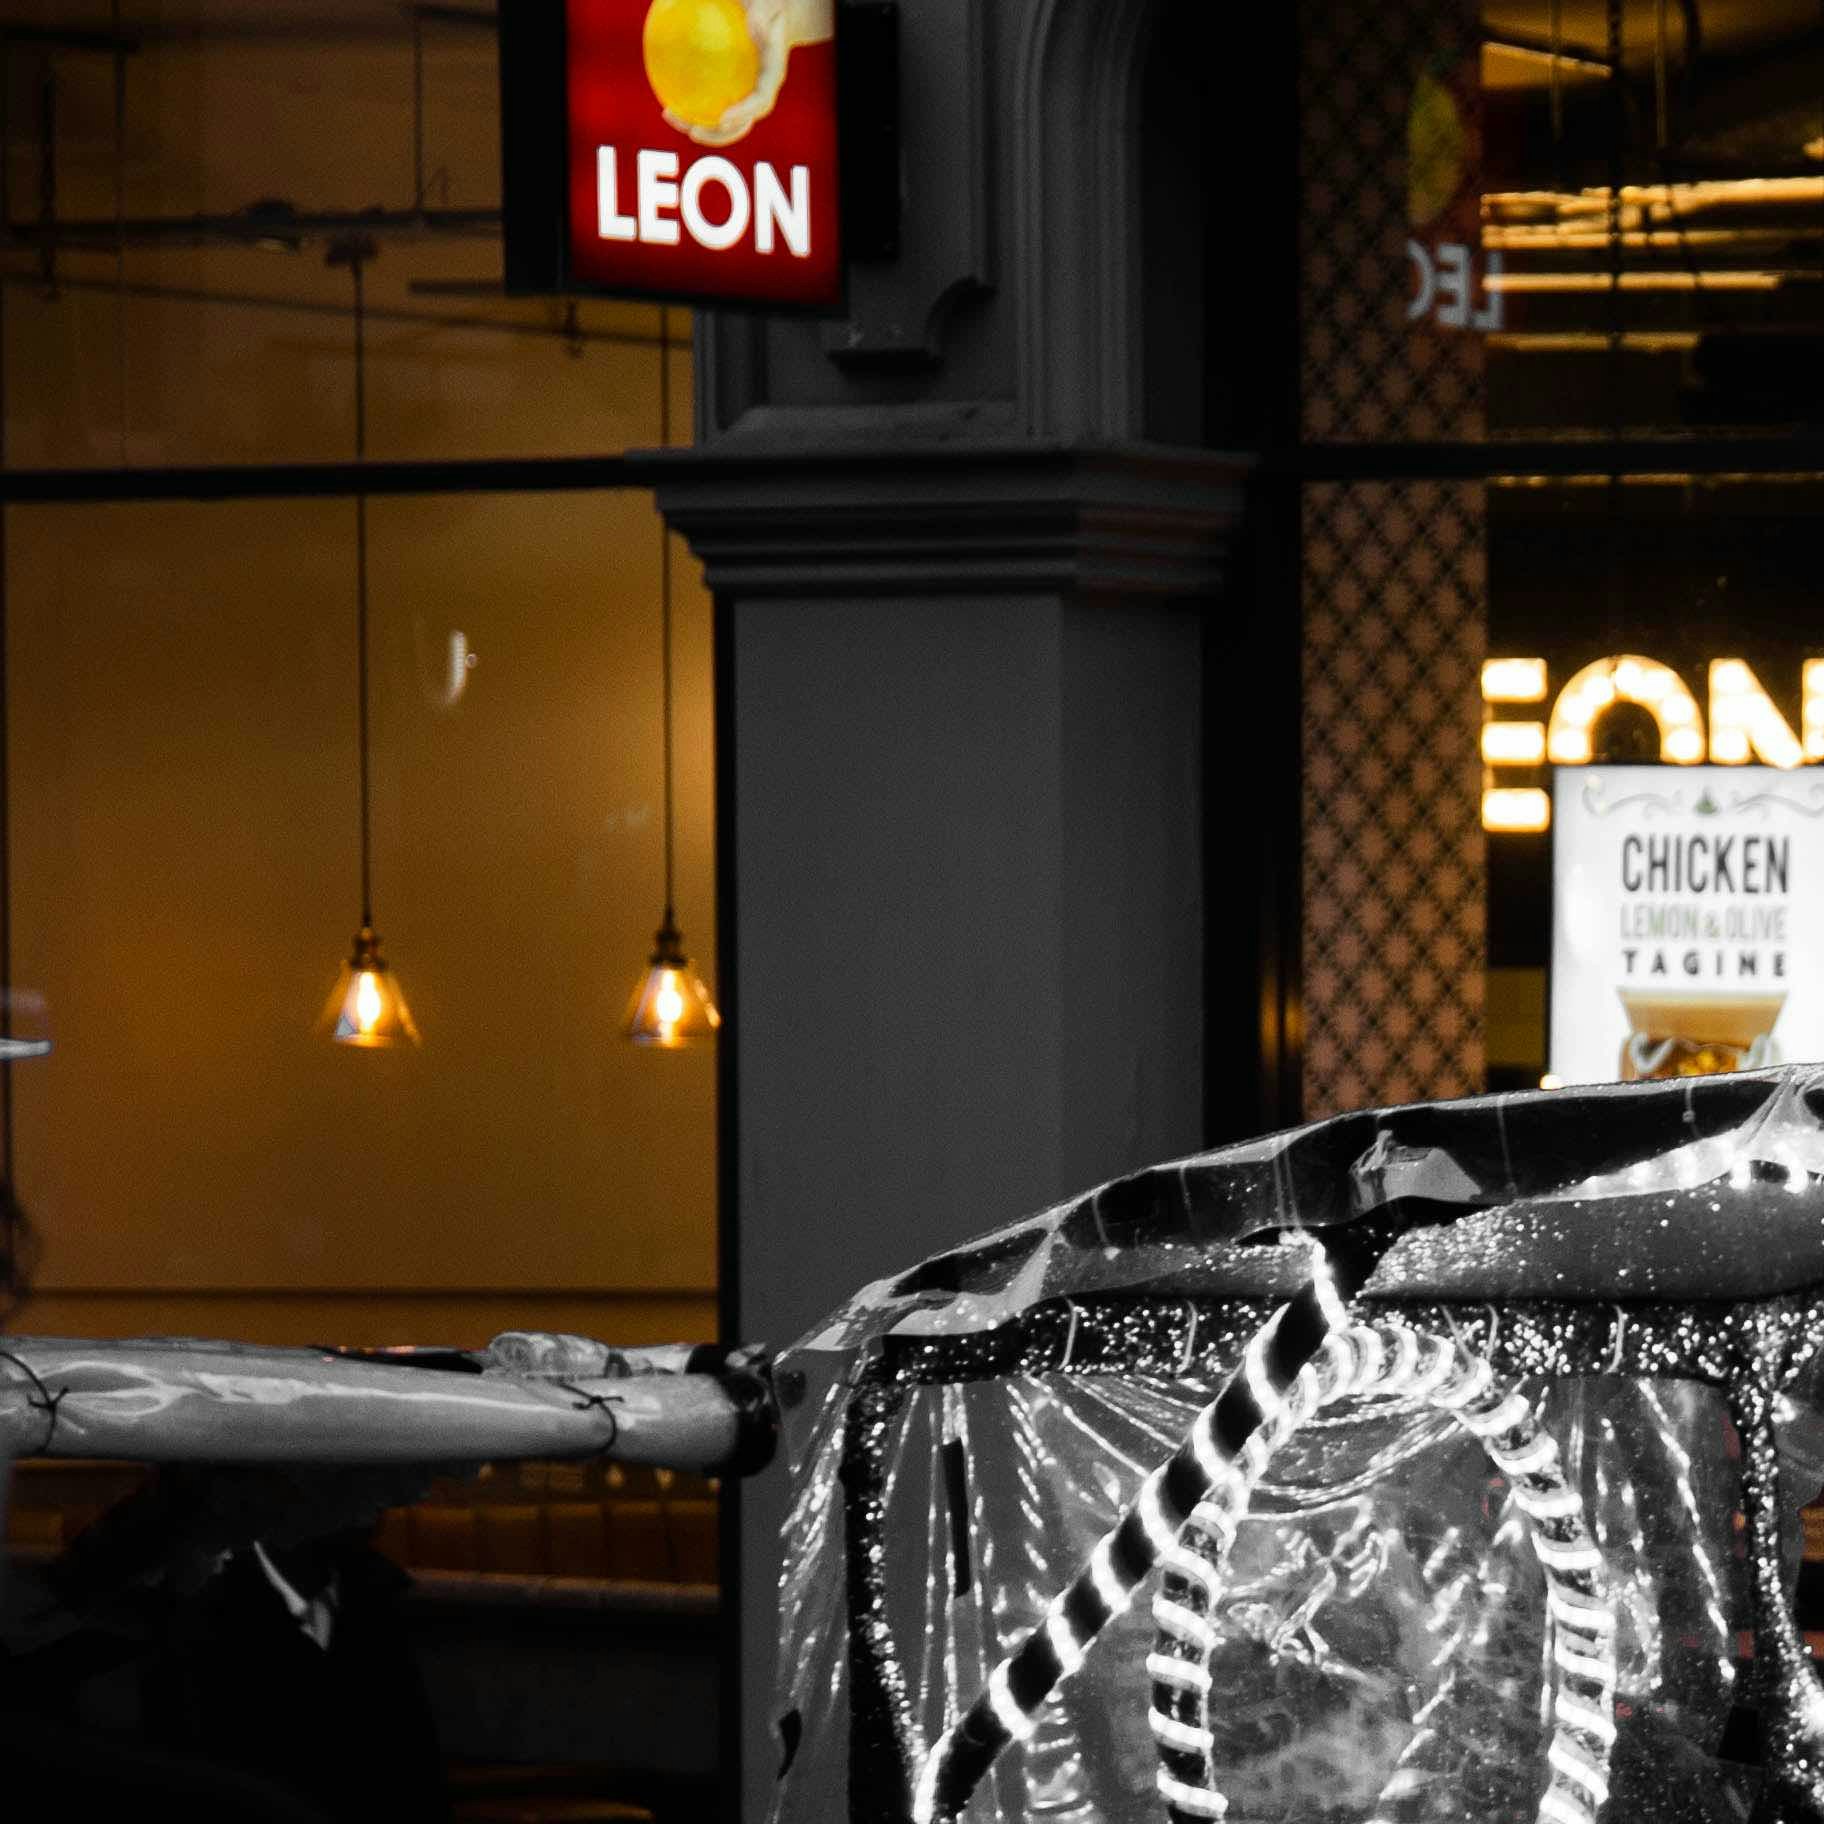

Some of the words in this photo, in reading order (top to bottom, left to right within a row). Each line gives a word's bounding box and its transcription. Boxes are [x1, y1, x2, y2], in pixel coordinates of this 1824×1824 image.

[597, 145, 811, 259] LEON
[1621, 833, 1791, 894] CHICKEN
[1619, 902, 1698, 941] LEMON
[1725, 902, 1789, 941] OLIVE
[1622, 947, 1787, 978] TAGINE
